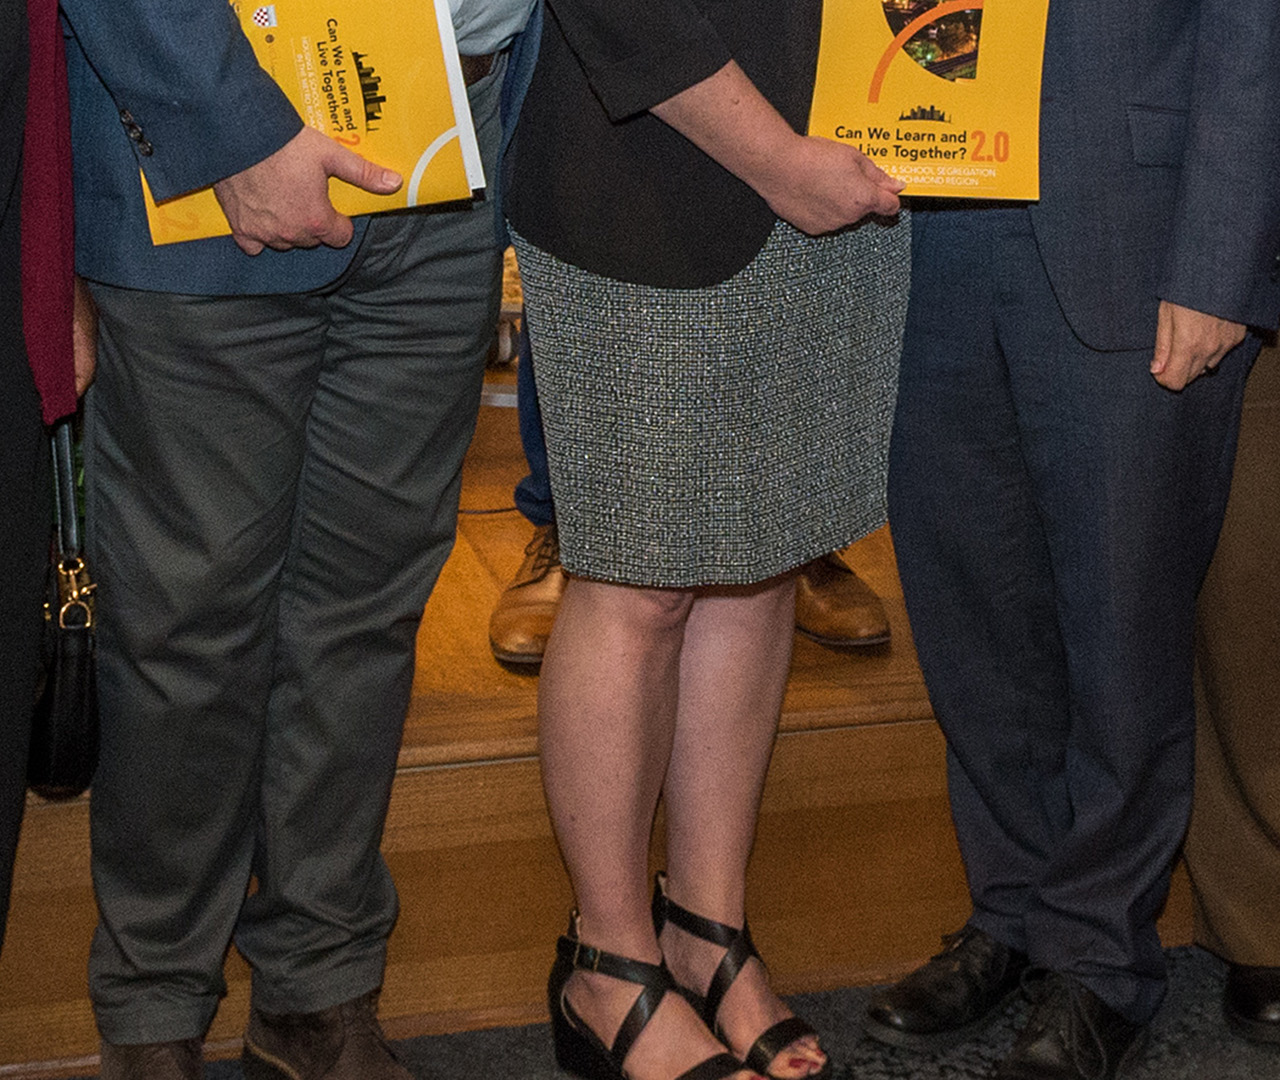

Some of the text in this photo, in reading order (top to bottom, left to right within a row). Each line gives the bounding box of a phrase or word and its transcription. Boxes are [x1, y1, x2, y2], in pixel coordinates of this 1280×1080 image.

[326, 18, 338, 42] Can
[332, 45, 344, 66] We
[317, 41, 344, 132] Live Together?
[336, 70, 349, 104] Learn
[343, 108, 358, 131] and
[835, 126, 967, 143] Can We Learn and
[859, 144, 967, 161] Live Together?
[970, 130, 1010, 163] 2.0
[891, 166, 897, 174] &
[899, 166, 936, 176] SCHOOL
[937, 167, 997, 178] SEGREGATION
[946, 177, 979, 187] REGION
